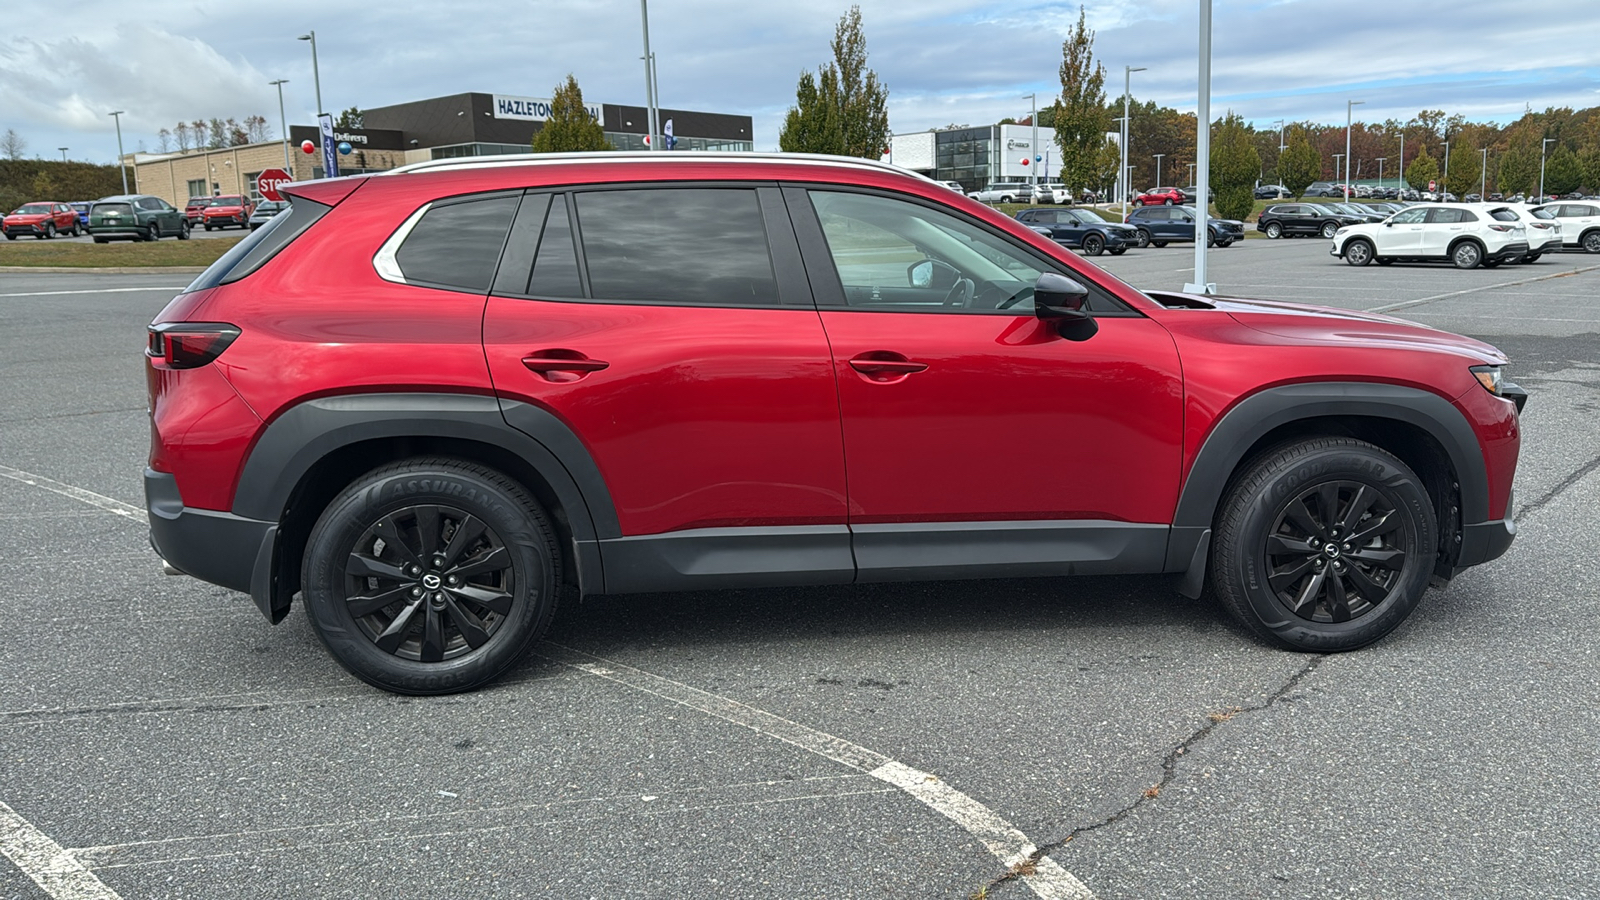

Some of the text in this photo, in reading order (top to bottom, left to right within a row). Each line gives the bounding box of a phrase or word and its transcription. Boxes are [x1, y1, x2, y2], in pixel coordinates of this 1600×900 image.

[498, 99, 554, 117] HAZLETON
[334, 132, 368, 144] Delivery
[393, 479, 516, 523] ASSURANCE
